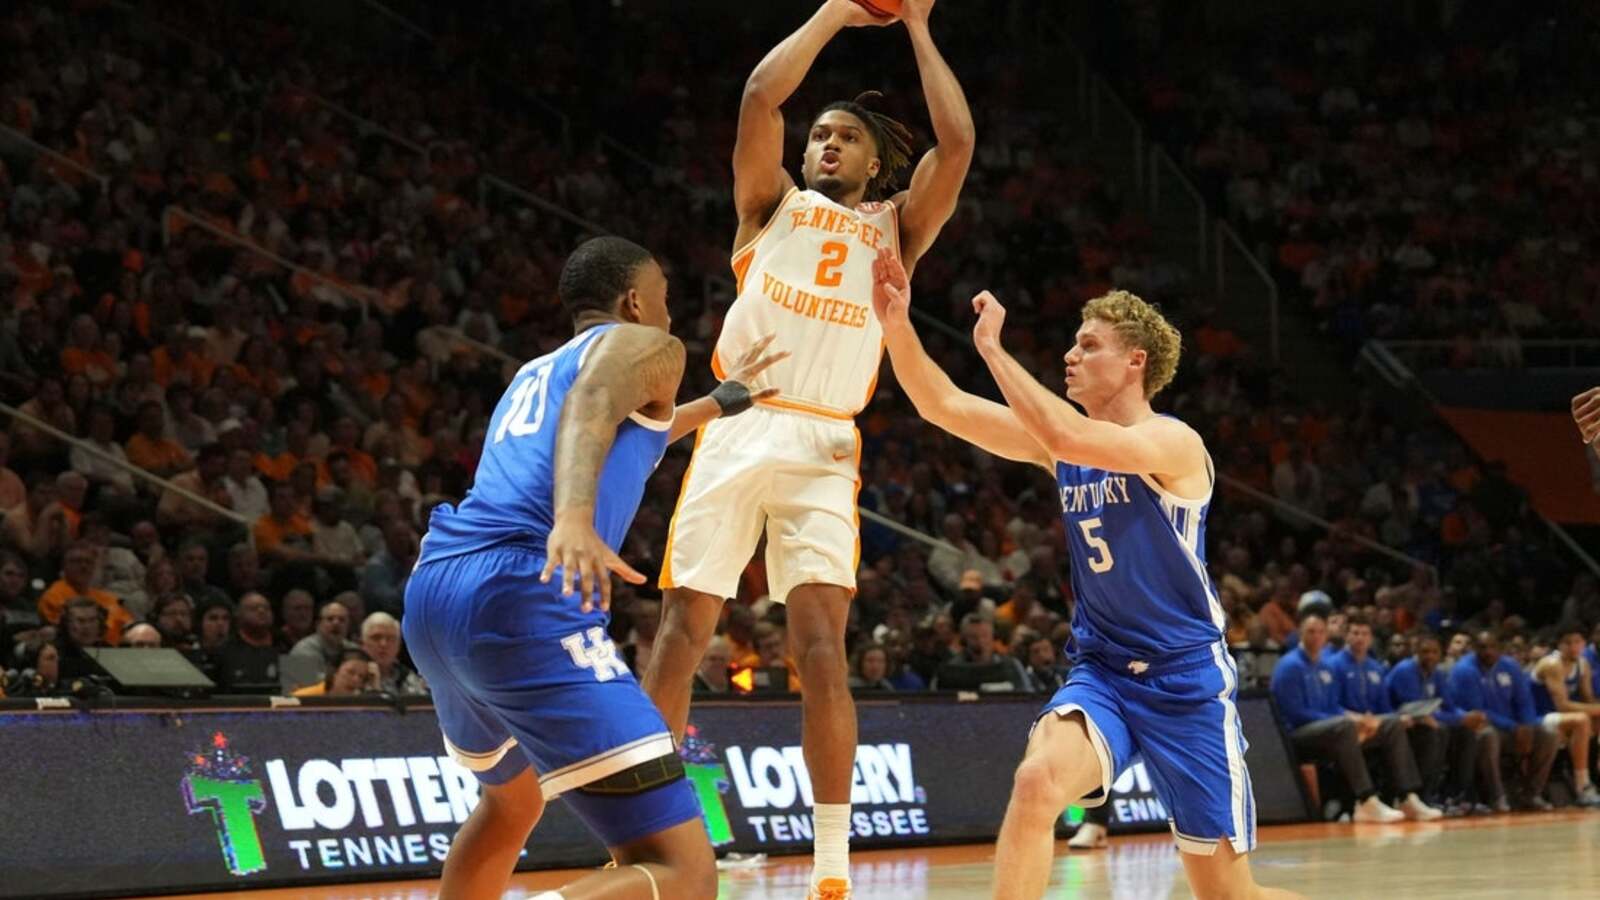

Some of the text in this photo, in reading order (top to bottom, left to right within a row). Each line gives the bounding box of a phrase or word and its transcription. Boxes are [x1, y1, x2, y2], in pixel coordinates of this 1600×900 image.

[791, 206, 884, 250] TENNESEE
[815, 240, 849, 288] 2
[762, 272, 870, 329] VOLUNTEERS
[493, 362, 555, 444] 10
[1078, 517, 1115, 574] 5
[559, 626, 631, 682] UK
[266, 755, 481, 831] LOTTER
[726, 743, 916, 809] LOTERY
[288, 833, 529, 871] TENNES
[746, 808, 930, 843] TENSSEE
